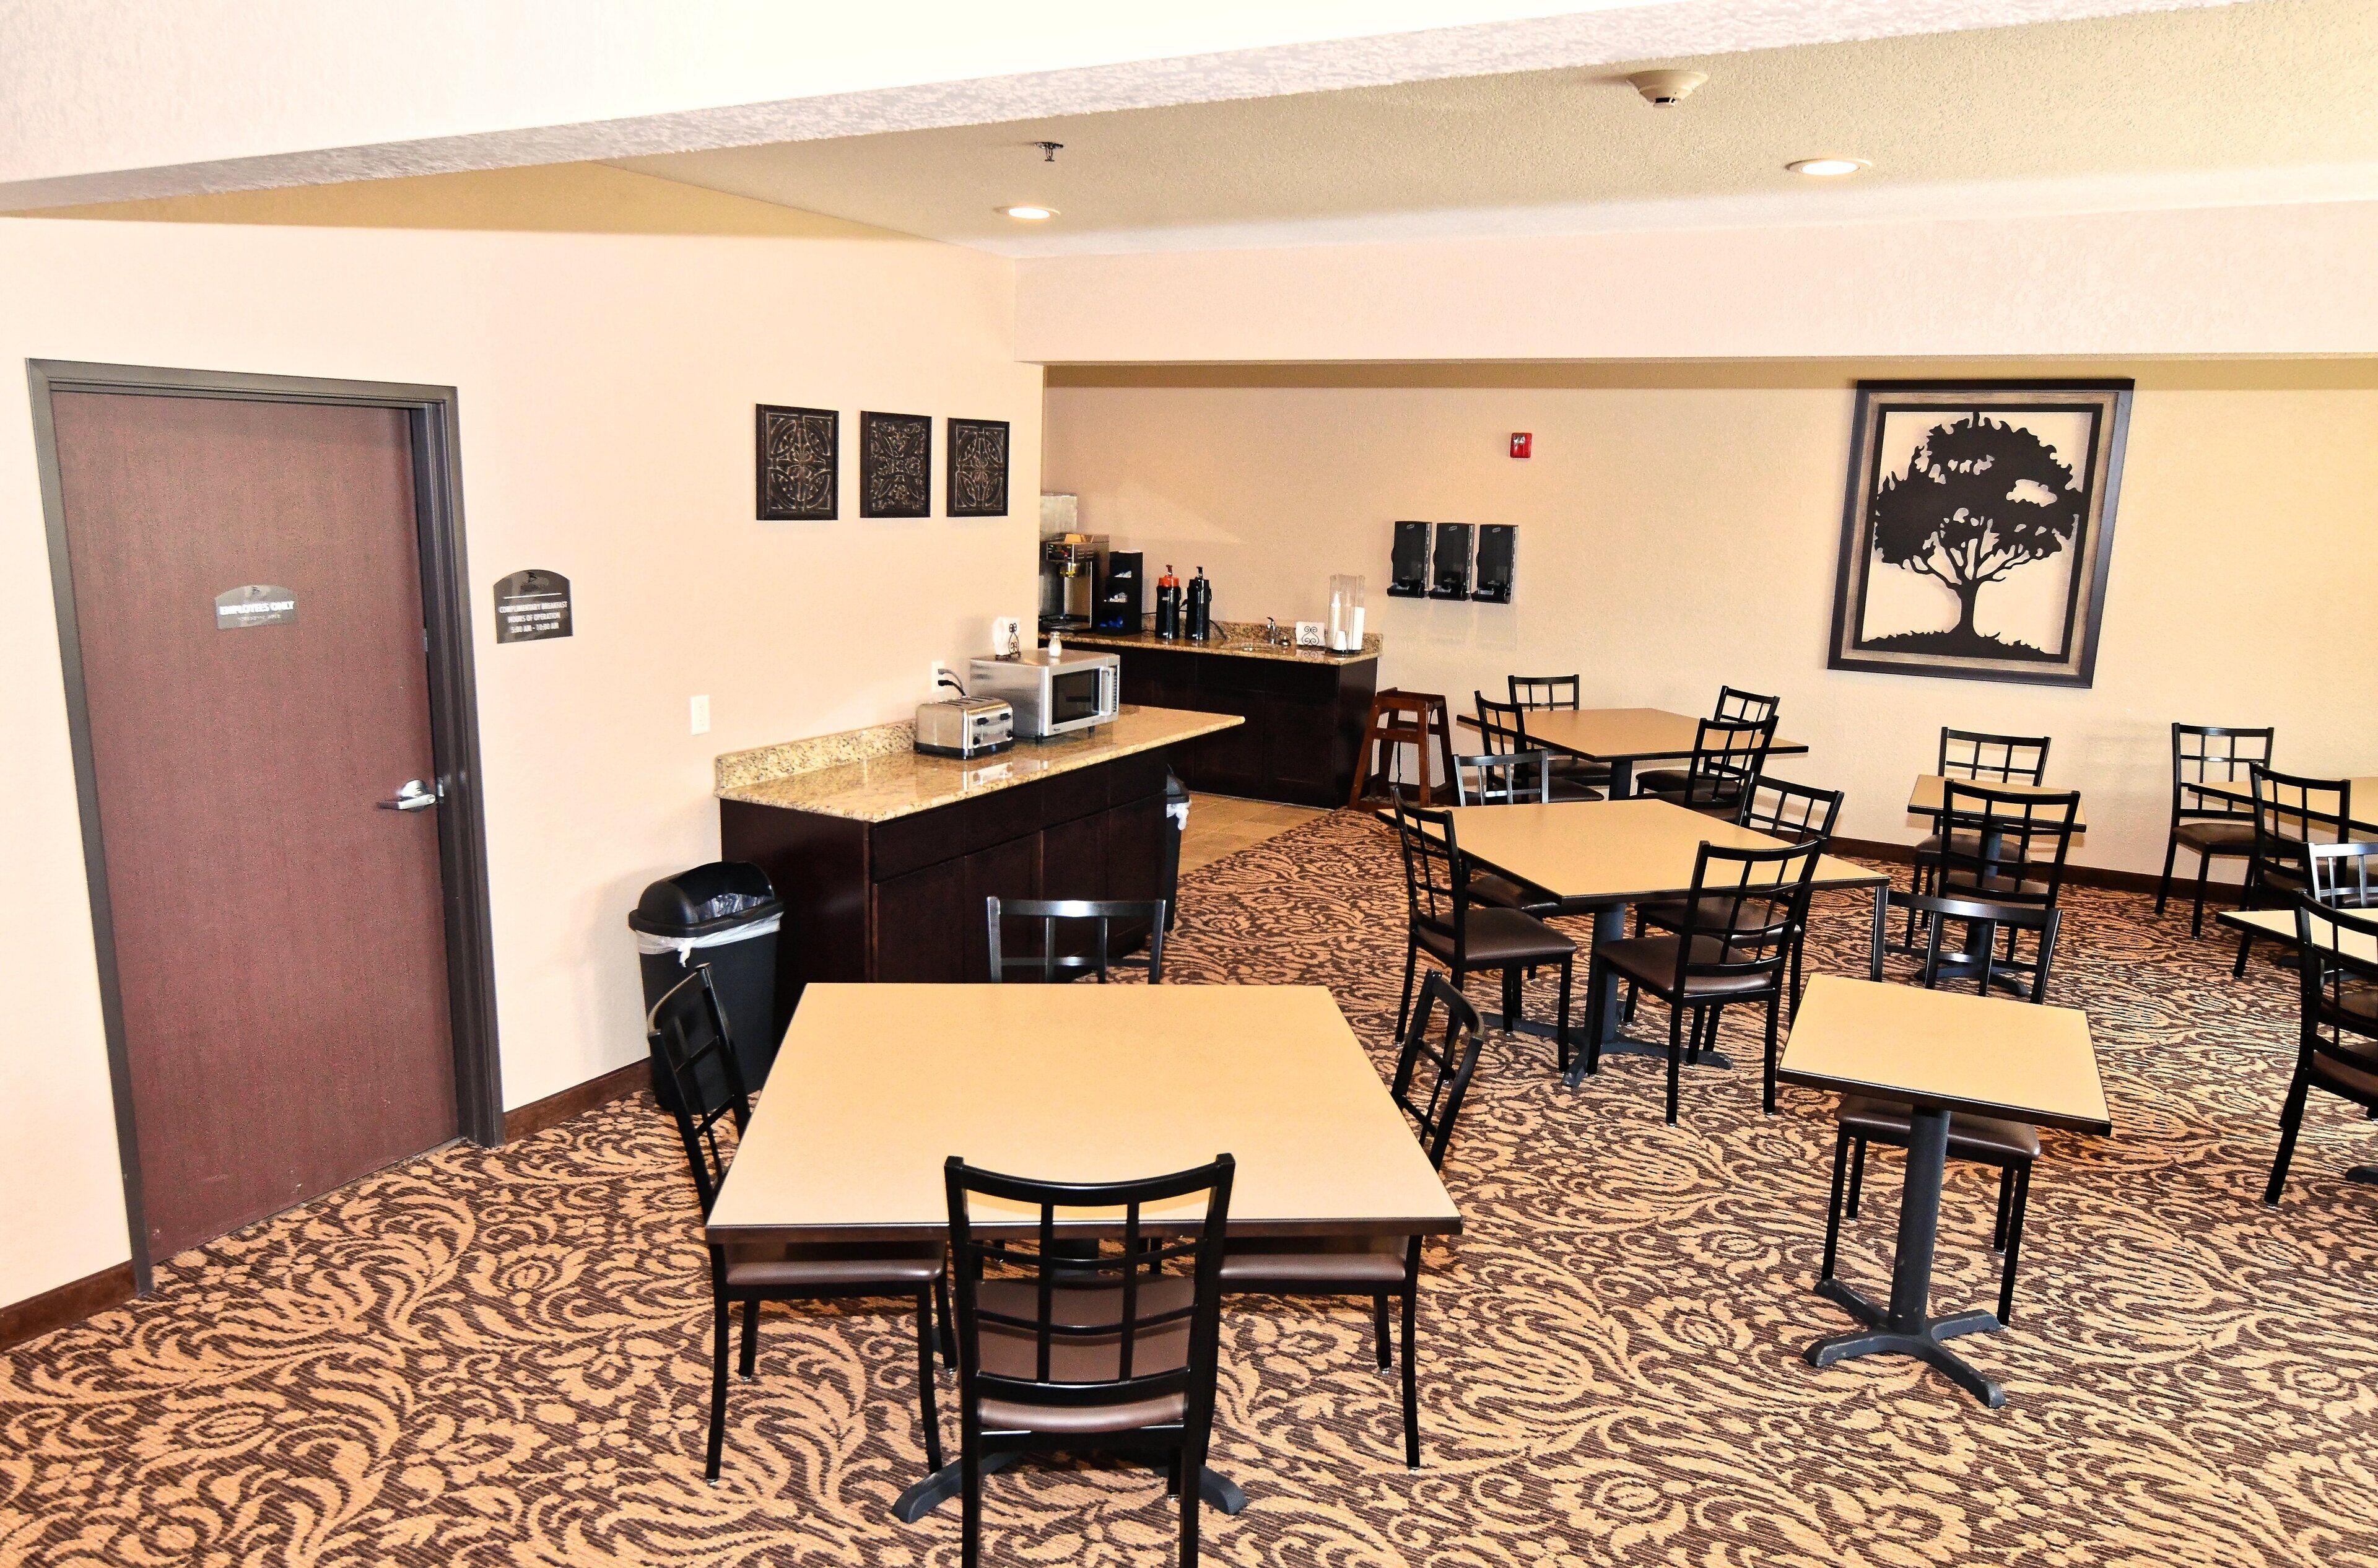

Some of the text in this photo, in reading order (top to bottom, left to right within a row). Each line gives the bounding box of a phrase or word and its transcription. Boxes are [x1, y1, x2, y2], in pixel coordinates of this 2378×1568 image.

[220, 601, 295, 616] EMPLOYEES ONLY
[508, 615, 526, 623] HOURS
[533, 612, 560, 621] OPERATION
